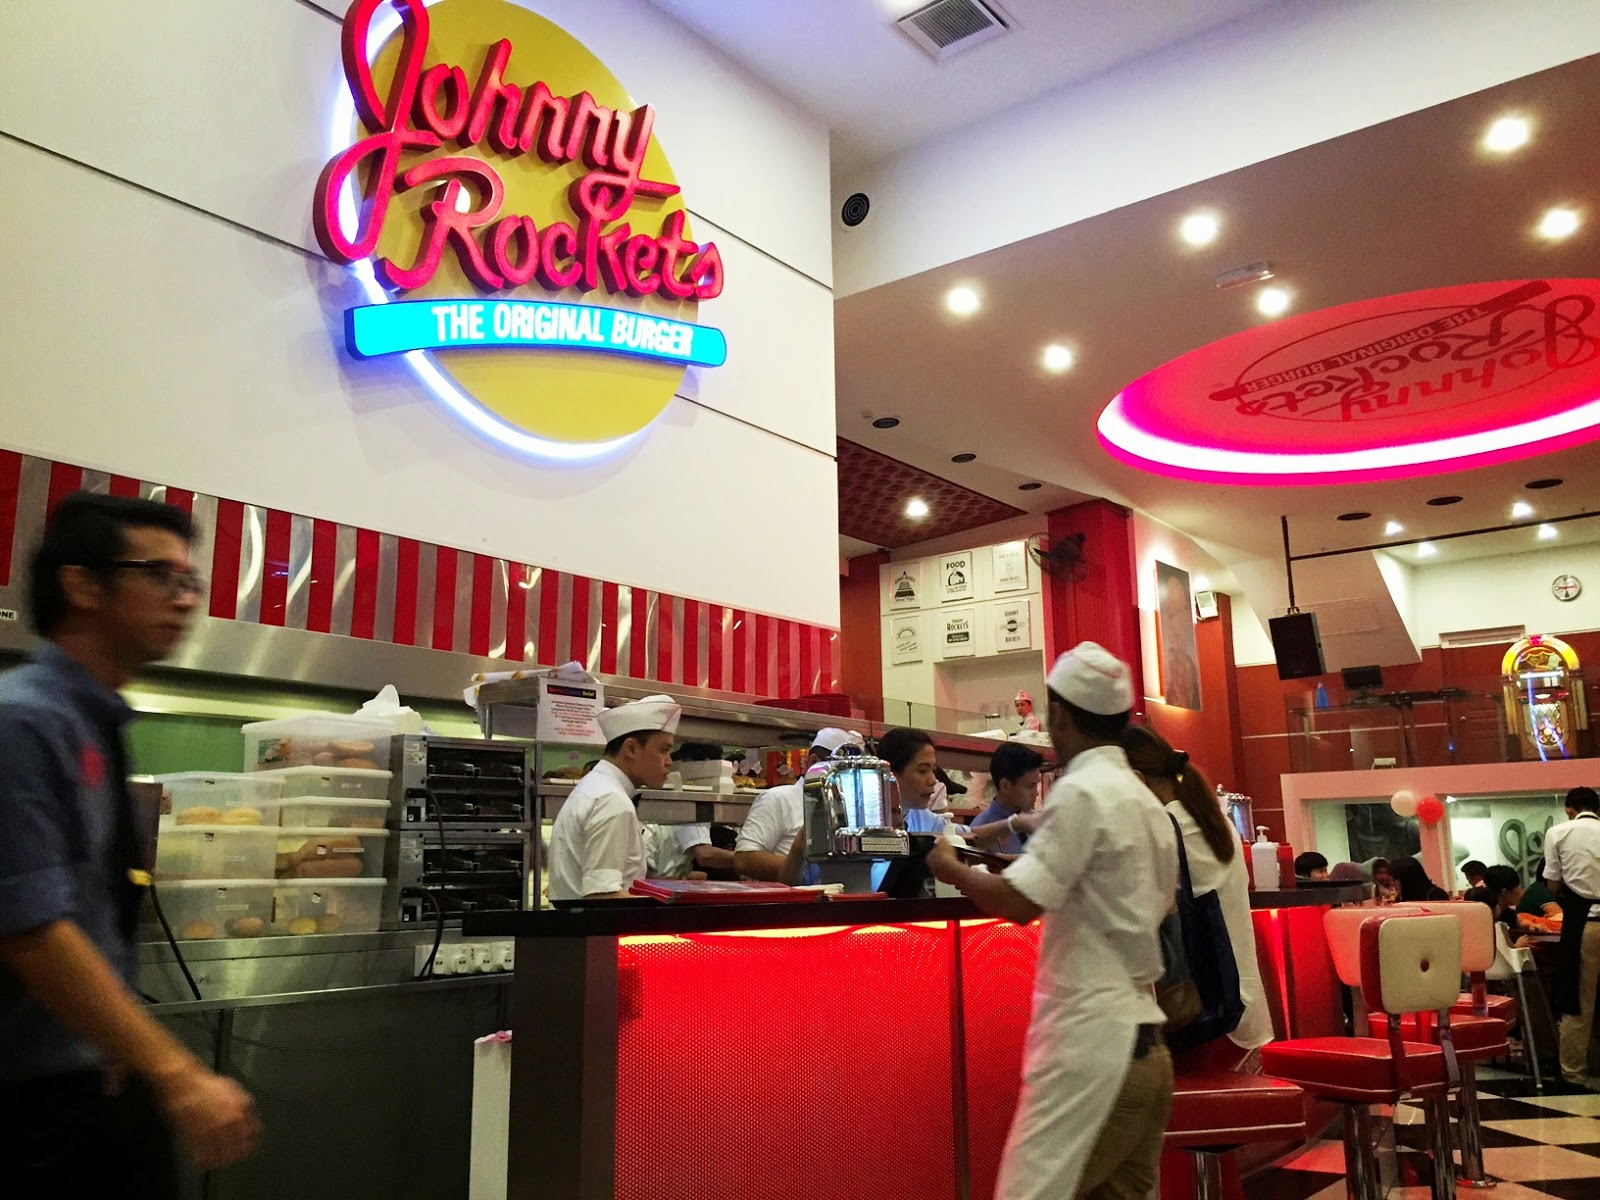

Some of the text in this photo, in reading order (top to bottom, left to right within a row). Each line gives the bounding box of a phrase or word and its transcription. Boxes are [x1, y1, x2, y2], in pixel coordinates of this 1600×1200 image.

[313, 0, 681, 264] Johnny
[373, 156, 724, 301] Rockets
[431, 303, 694, 357] THE ORIGINAL BURGER
[1236, 305, 1544, 416] Rockets
[1245, 306, 1488, 392] THE ORIGINAL BURGER
[1302, 295, 1600, 421] Johnny
[946, 561, 966, 570] FOOD
[0, 611, 15, 619] NE
